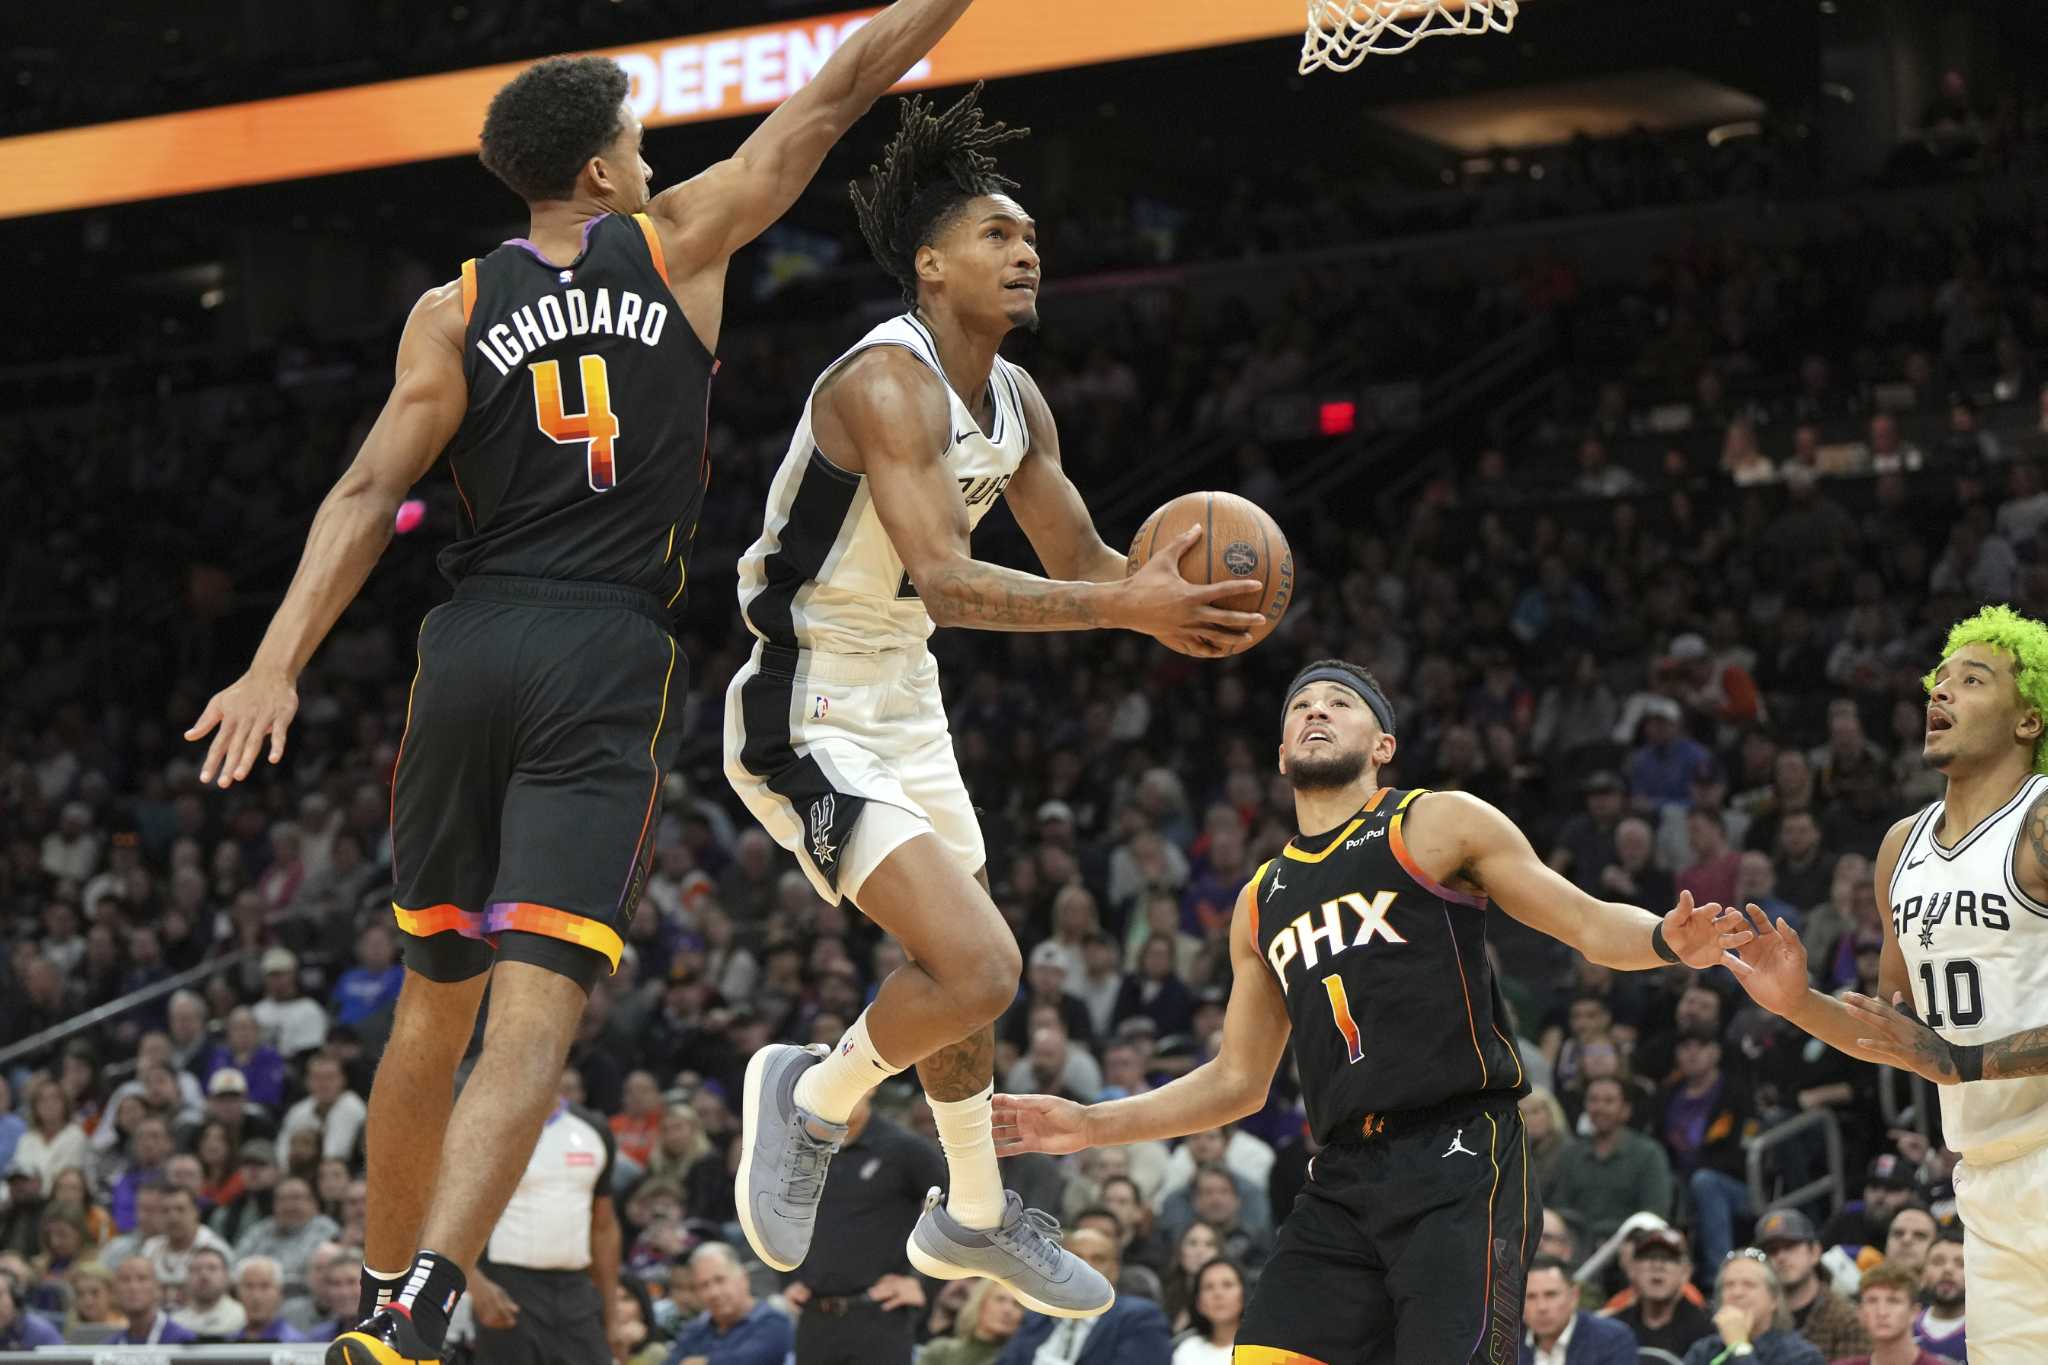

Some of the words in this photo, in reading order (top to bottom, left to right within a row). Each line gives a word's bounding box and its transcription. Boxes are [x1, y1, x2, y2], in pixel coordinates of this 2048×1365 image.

[614, 17, 931, 118] DEFEN
[476, 287, 668, 376] IGHODARO
[528, 354, 620, 493] 4
[1346, 826, 1385, 850] PayPal
[1268, 891, 1408, 996] PHX
[1321, 973, 1365, 1064] 1
[1919, 957, 1985, 1030] 10
